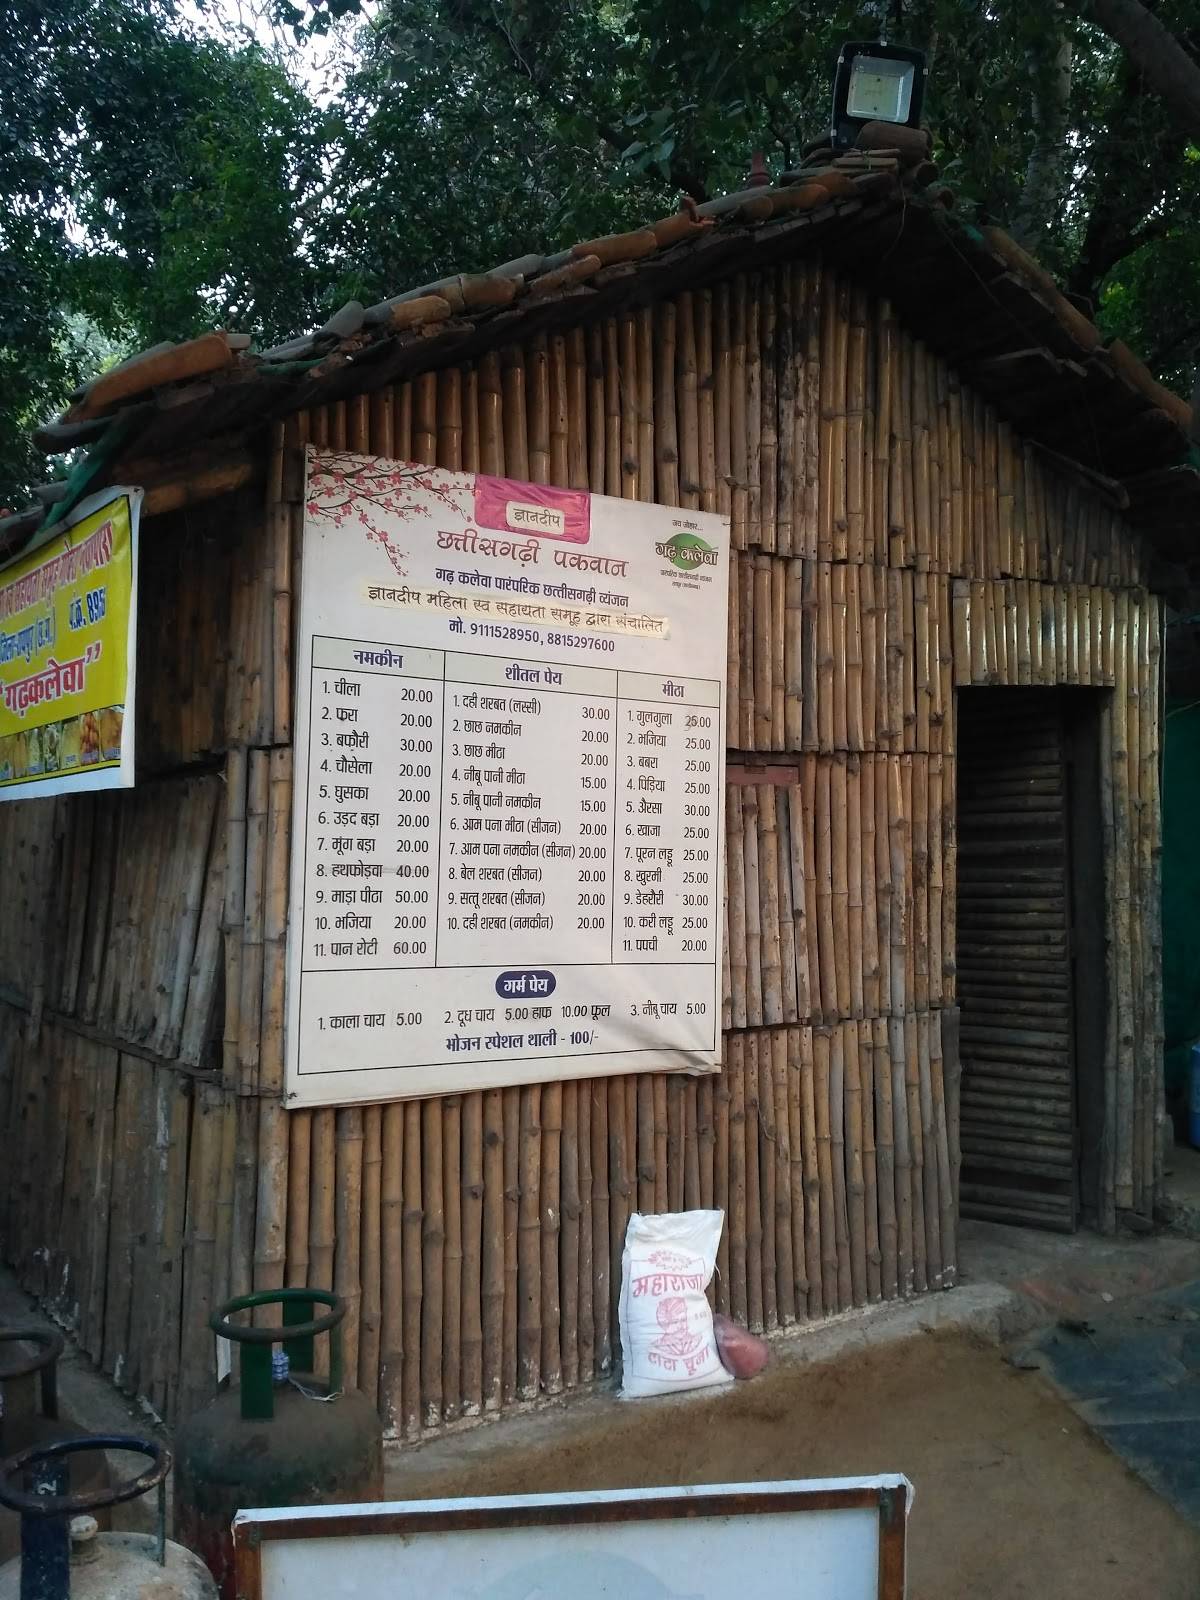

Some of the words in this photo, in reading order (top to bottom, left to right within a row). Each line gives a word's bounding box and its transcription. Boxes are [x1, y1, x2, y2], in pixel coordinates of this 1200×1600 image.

[513, 508, 562, 528] ज्ञानदीप
[436, 528, 541, 568] छत्तीसगढ़ी
[554, 549, 629, 578] पकवान
[655, 541, 677, 563] गढ़
[680, 543, 719, 566] कलेवा
[436, 567, 454, 585] गढ़
[458, 567, 492, 589] कलेवा
[495, 575, 540, 595] पारंपरिक
[543, 582, 596, 606] छत्तीसगढ़ी
[599, 591, 629, 608] व्यंजन
[368, 585, 421, 605] ज्ञानदीप
[426, 590, 468, 611] महिला
[473, 599, 490, 612] स्व
[496, 601, 546, 618] सहायता
[550, 608, 581, 627] समूह
[585, 612, 611, 626] द्वारा
[616, 613, 664, 633] संचालित
[448, 616, 466, 634] मो.
[470, 623, 544, 646] 9111528950,
[547, 633, 615, 652] 8815297600
[353, 649, 403, 669] नमकीन
[505, 663, 540, 683] शीतल
[544, 667, 563, 685] पेय
[323, 681, 331, 694] 1.
[334, 678, 361, 696] चीला
[401, 688, 433, 703] 20.00
[662, 680, 685, 698] मीठा
[463, 692, 478, 709] दही
[480, 697, 506, 712] शरबत
[509, 698, 541, 715] (लस्सी)
[582, 706, 610, 721] 30.00
[321, 707, 332, 720] 2.
[336, 708, 358, 722] फरा
[400, 714, 432, 728] 20.00
[636, 711, 672, 728] गुलगुला
[464, 720, 483, 734] छाछ
[485, 720, 522, 737] नमकीन
[581, 731, 609, 744] 20.00
[638, 730, 667, 747] भजिया
[685, 738, 711, 751] 25.00
[321, 733, 332, 746] 3.
[400, 739, 433, 753] 30.00
[464, 744, 483, 758] छाछ
[485, 742, 506, 760] मीठा
[581, 754, 609, 767] 20.00
[638, 756, 659, 769] बबरा
[685, 760, 710, 773] 25.00
[320, 759, 332, 773] 4.
[336, 755, 373, 775] चौसेला
[400, 764, 431, 778] 20.00
[464, 765, 483, 787] नीबू
[484, 766, 503, 784] पानी
[506, 768, 526, 785] मीठा
[580, 777, 607, 790] 15.00
[319, 785, 330, 798] 5.
[399, 789, 430, 803] 20.00
[685, 782, 710, 795] 25.00
[463, 789, 482, 811] नीबू
[483, 791, 503, 808] पानी
[505, 792, 541, 810] नमकीन
[581, 800, 606, 813] 15.00
[684, 805, 710, 817] 30.00
[318, 812, 330, 825] 6.
[333, 812, 358, 828] उड़द
[361, 813, 380, 828] बड़ा
[397, 815, 430, 828] 20.00
[462, 818, 482, 831] आम
[485, 819, 502, 831] पना
[505, 816, 524, 833] मीठा
[527, 817, 561, 835] (सीजन)
[579, 823, 607, 836] 20.00
[637, 824, 661, 837] खाजा
[684, 827, 709, 839] 25.00
[317, 838, 328, 851] 7.
[332, 836, 354, 856] मूंग
[357, 838, 376, 854] बड़ा
[396, 840, 429, 853] 20.00
[461, 842, 480, 856] आम
[483, 843, 500, 856] पना
[503, 841, 539, 857] नमकीन
[542, 841, 576, 860] (सीजन)
[579, 847, 606, 859] 20.00
[636, 848, 656, 863] पूरन
[683, 849, 709, 861] 25.00
[316, 864, 328, 877] 8.
[332, 860, 383, 880] हथफोड़वा
[396, 865, 430, 878] 40.00
[461, 863, 475, 880] बेल
[479, 867, 505, 880] शरबत
[507, 865, 542, 882] (सीजन)
[578, 870, 606, 882] 20.00
[636, 867, 662, 886] खुरमी
[682, 872, 708, 884] 25.00
[316, 891, 327, 904] 9.
[331, 890, 357, 906] माड़ा
[360, 886, 383, 904] पीठा
[395, 890, 429, 904] 50.00
[460, 892, 480, 909] सत्तू
[482, 892, 508, 905] शरबत
[510, 889, 545, 907] (सीजन)
[578, 894, 605, 906] 20.00
[682, 894, 708, 906] 30.00
[315, 917, 331, 930] 10.
[335, 912, 372, 930] भजिया
[394, 916, 427, 929] 20.00
[463, 913, 478, 930] दही
[481, 917, 507, 930] शरबत
[509, 913, 554, 931] (नमकीन)
[577, 917, 605, 929] 20.00
[638, 912, 657, 928] करी
[682, 917, 708, 929] 25.00
[313, 944, 327, 957] 11.
[330, 943, 353, 956] पान
[357, 938, 378, 956] रोटी
[393, 942, 427, 955] 60.00
[636, 936, 658, 952] पपची
[681, 940, 707, 952] 20.00
[503, 975, 526, 993] गर्म
[529, 976, 548, 992] पेय
[457, 1009, 472, 1027] दूध
[475, 1008, 495, 1022] चाय
[505, 1008, 529, 1021] 5.00
[531, 1006, 552, 1020] हाफ
[562, 1005, 588, 1018] 10.00
[590, 1004, 611, 1021] फूल
[642, 1000, 661, 1020] नीबू
[660, 1002, 677, 1015] चाय
[686, 1003, 706, 1015] 5.00
[329, 1014, 360, 1030] काला
[364, 1013, 385, 1028] चाय
[396, 1012, 422, 1026] 5.00
[445, 1033, 481, 1051] भोजन
[484, 1031, 524, 1050] स्पेशल
[528, 1029, 557, 1047] थाली
[632, 1273, 704, 1298] महाराजा
